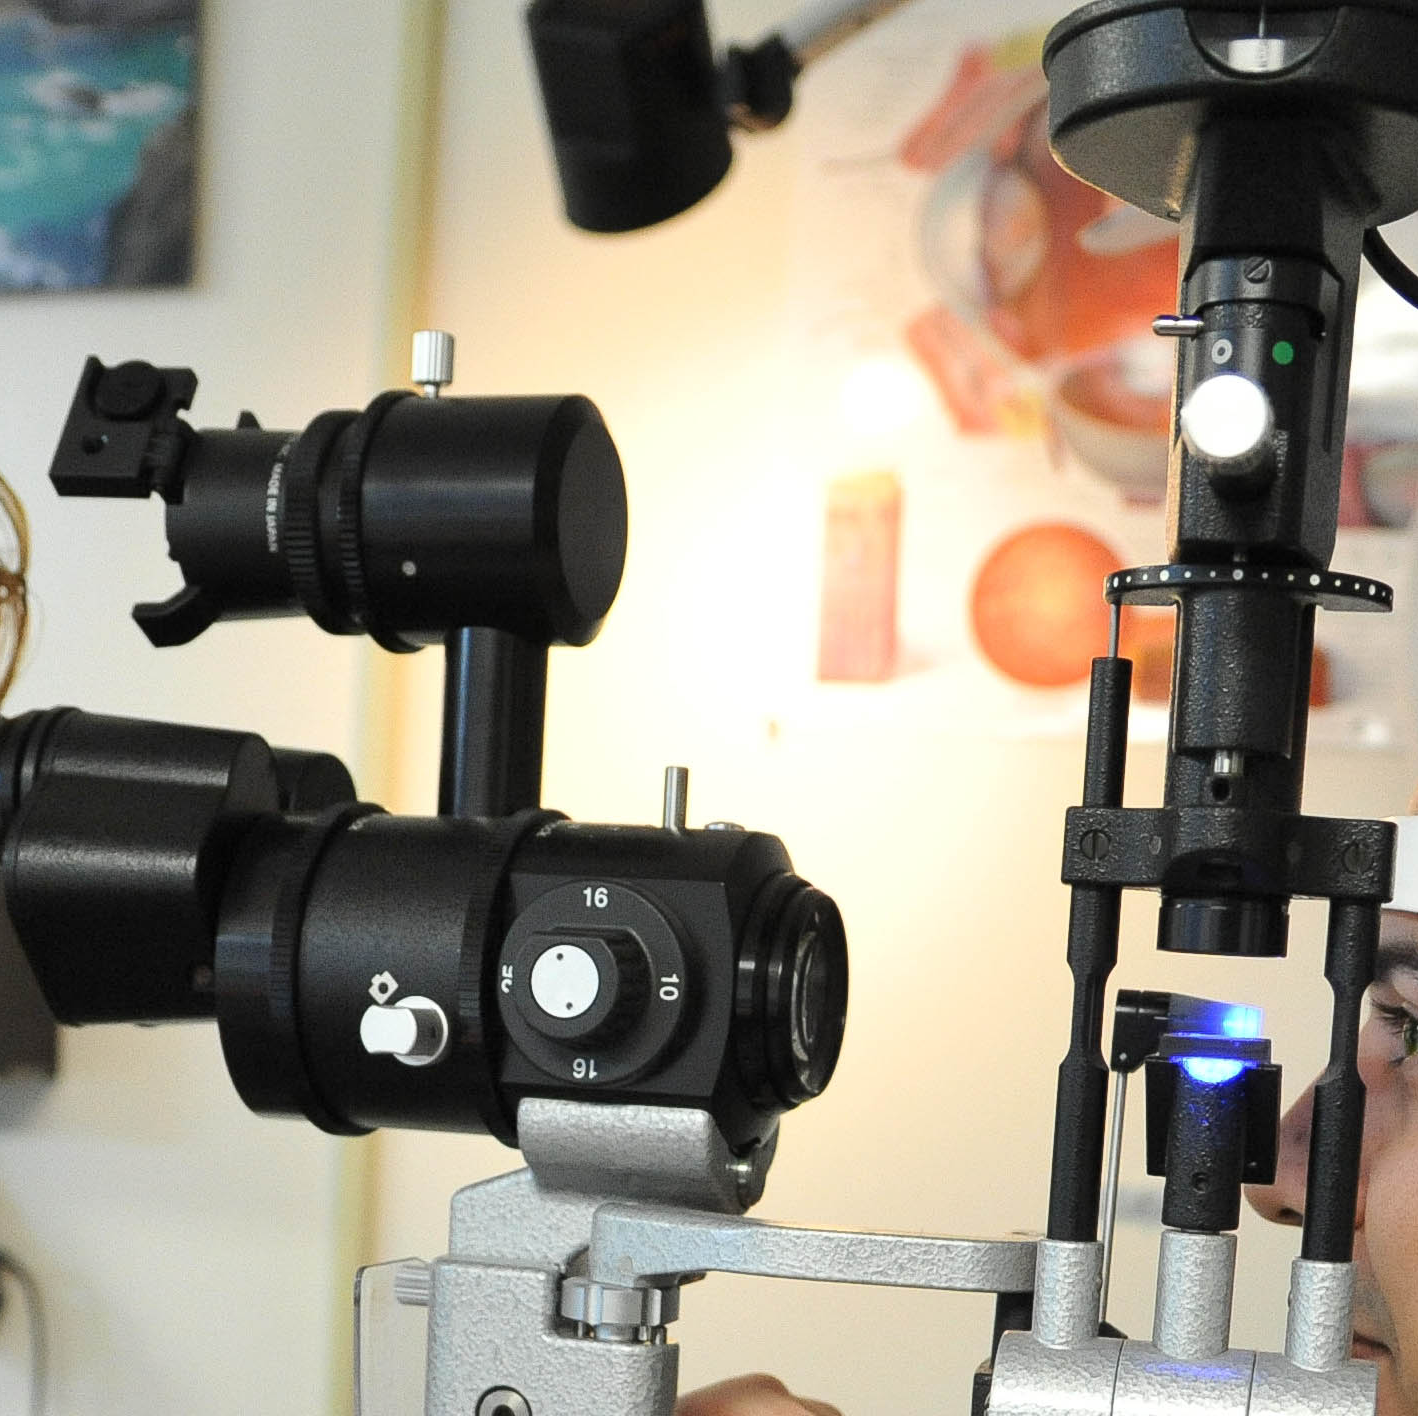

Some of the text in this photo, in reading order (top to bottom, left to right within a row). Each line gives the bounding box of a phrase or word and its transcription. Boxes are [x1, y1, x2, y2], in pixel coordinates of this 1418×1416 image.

[583, 887, 609, 908] 16
[659, 973, 680, 1001] 10
[572, 1058, 597, 1080] 16
